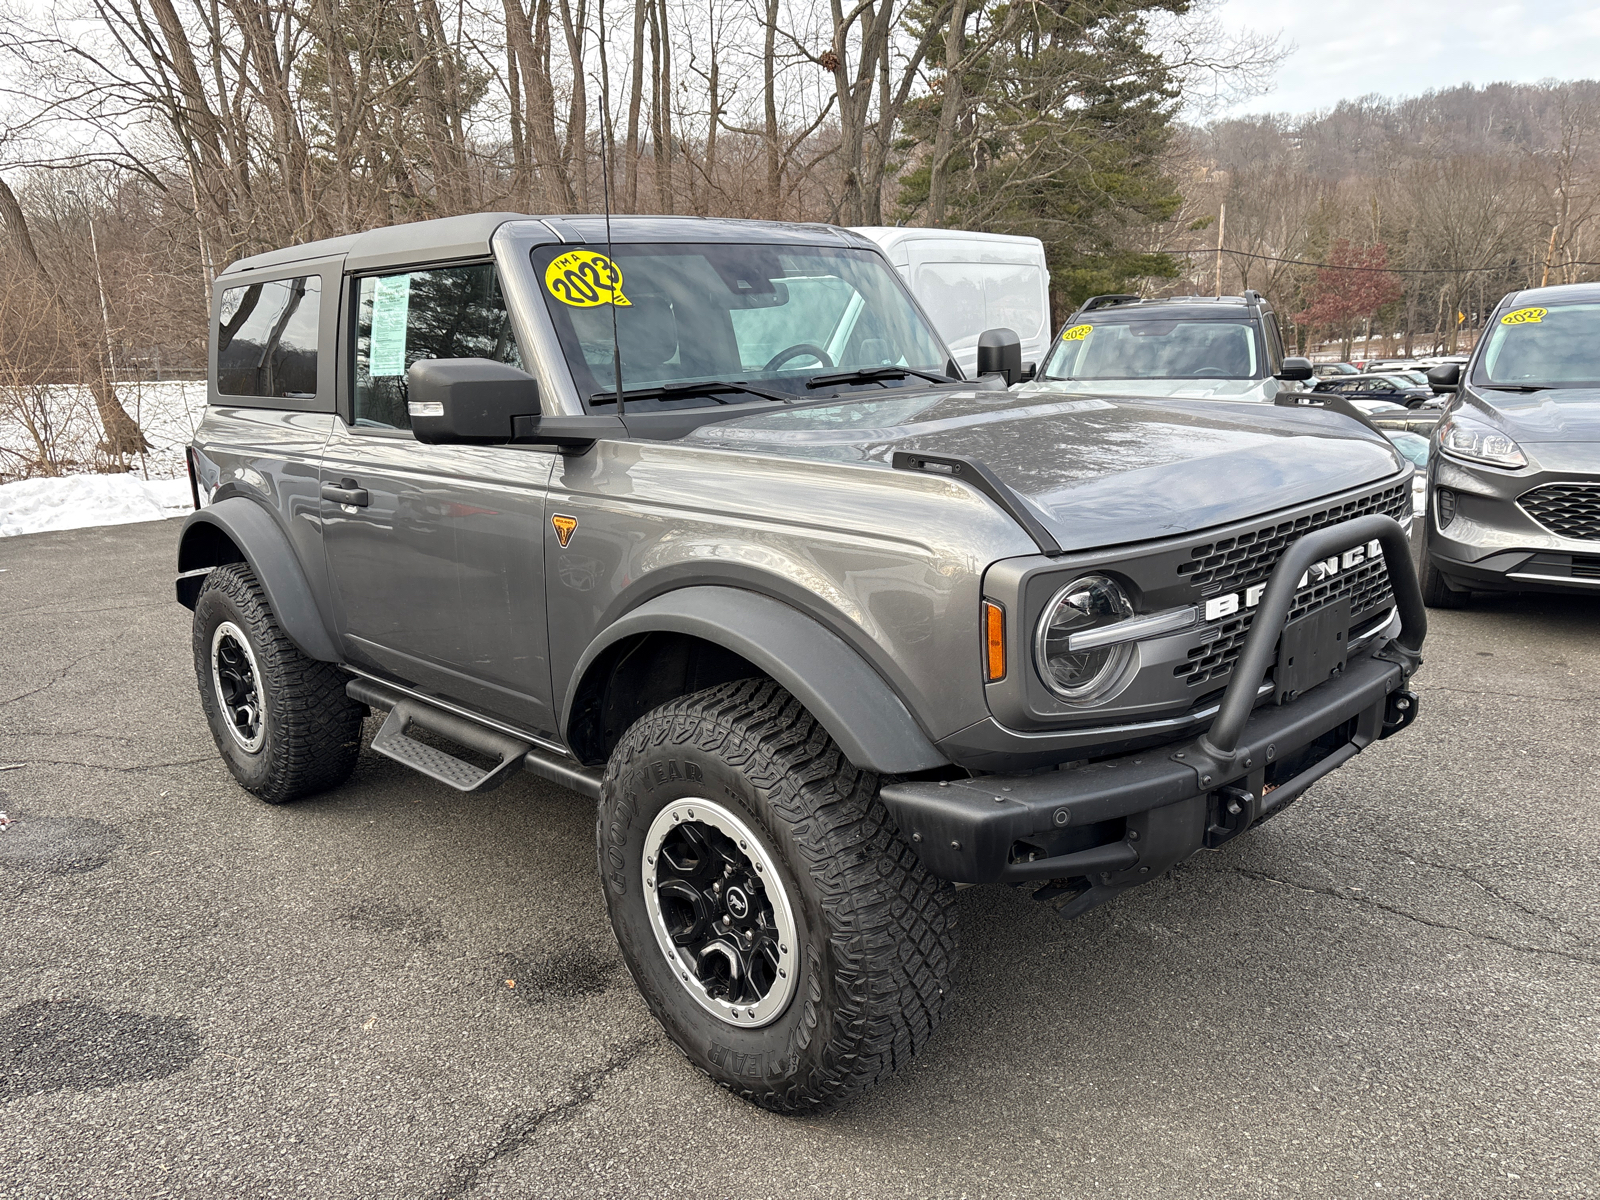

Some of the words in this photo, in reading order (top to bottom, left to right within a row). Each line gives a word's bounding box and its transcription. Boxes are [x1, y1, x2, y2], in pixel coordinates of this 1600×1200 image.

[554, 258, 572, 270] I'M
[572, 253, 581, 262] A
[552, 257, 619, 303] 2023
[1504, 308, 1546, 323] 2022
[1064, 325, 1092, 340] 2023
